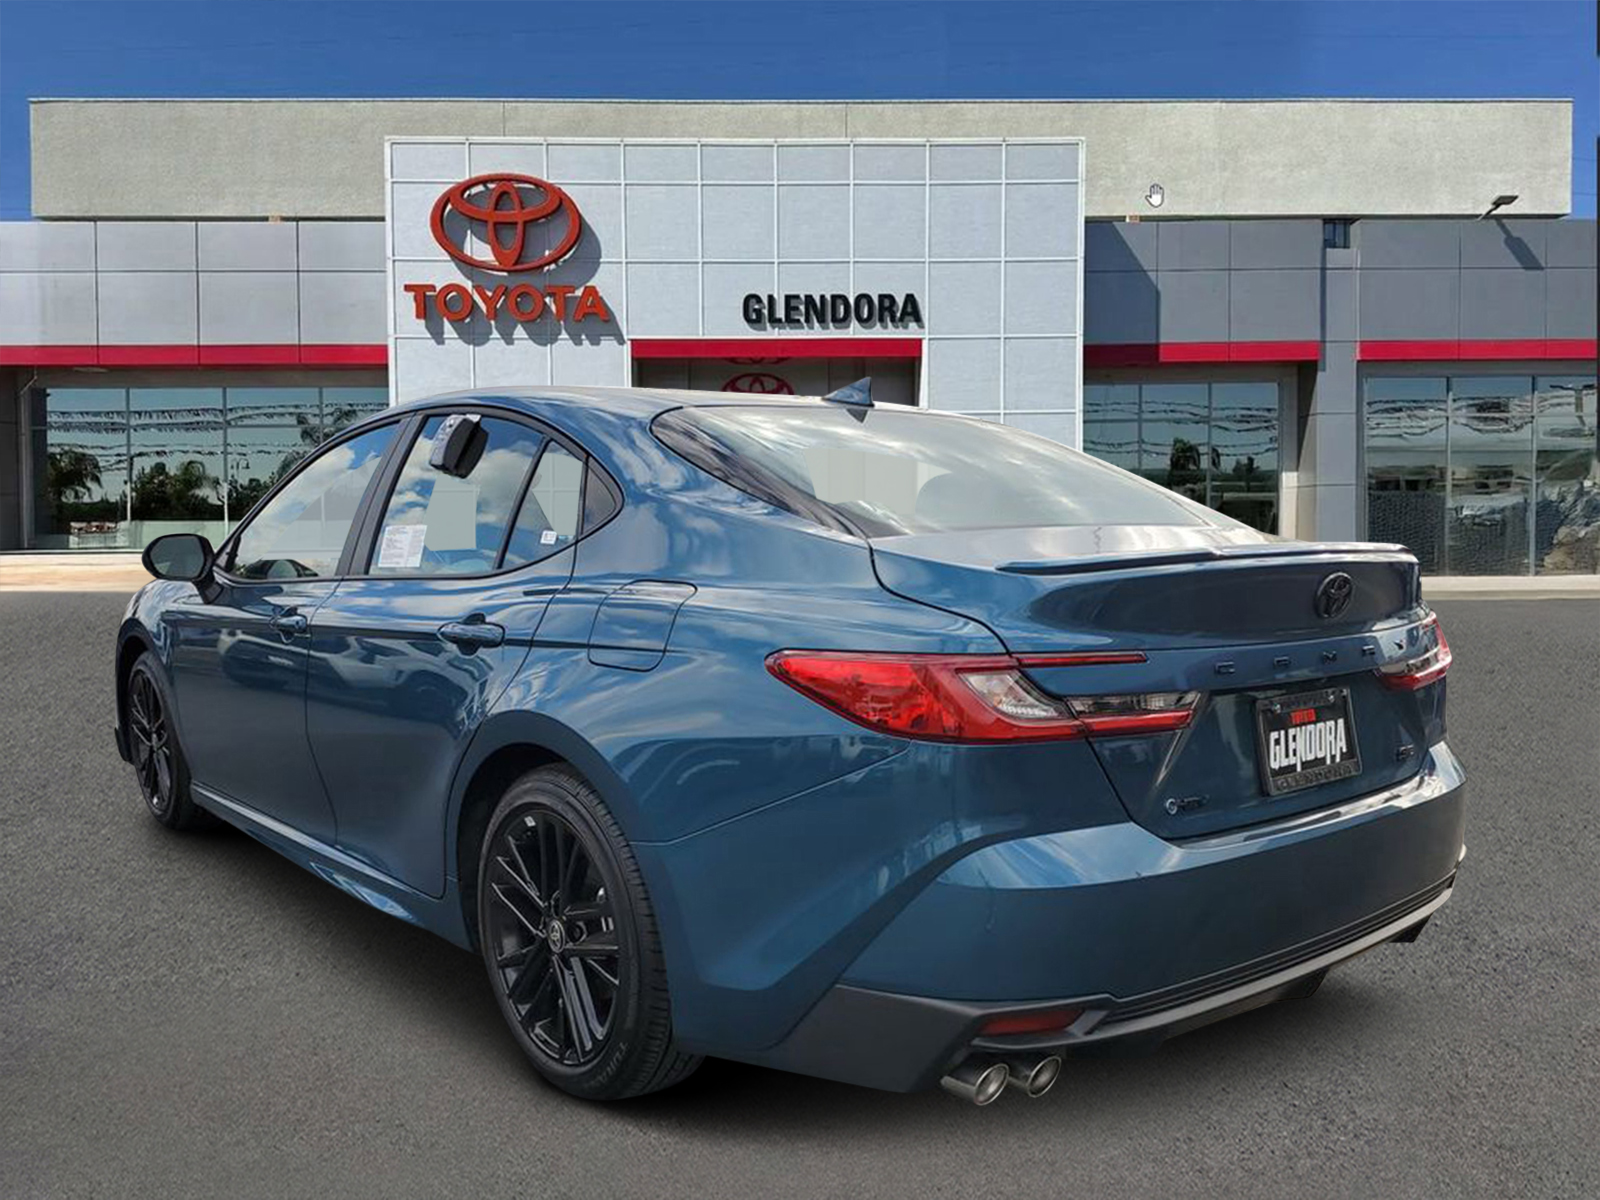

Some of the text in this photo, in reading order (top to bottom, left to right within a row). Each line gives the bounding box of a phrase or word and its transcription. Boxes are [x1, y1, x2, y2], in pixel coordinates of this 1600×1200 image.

[404, 283, 610, 322] TOYOTA
[742, 293, 924, 326] GLENDORA
[1269, 718, 1347, 772] GLENDORA
